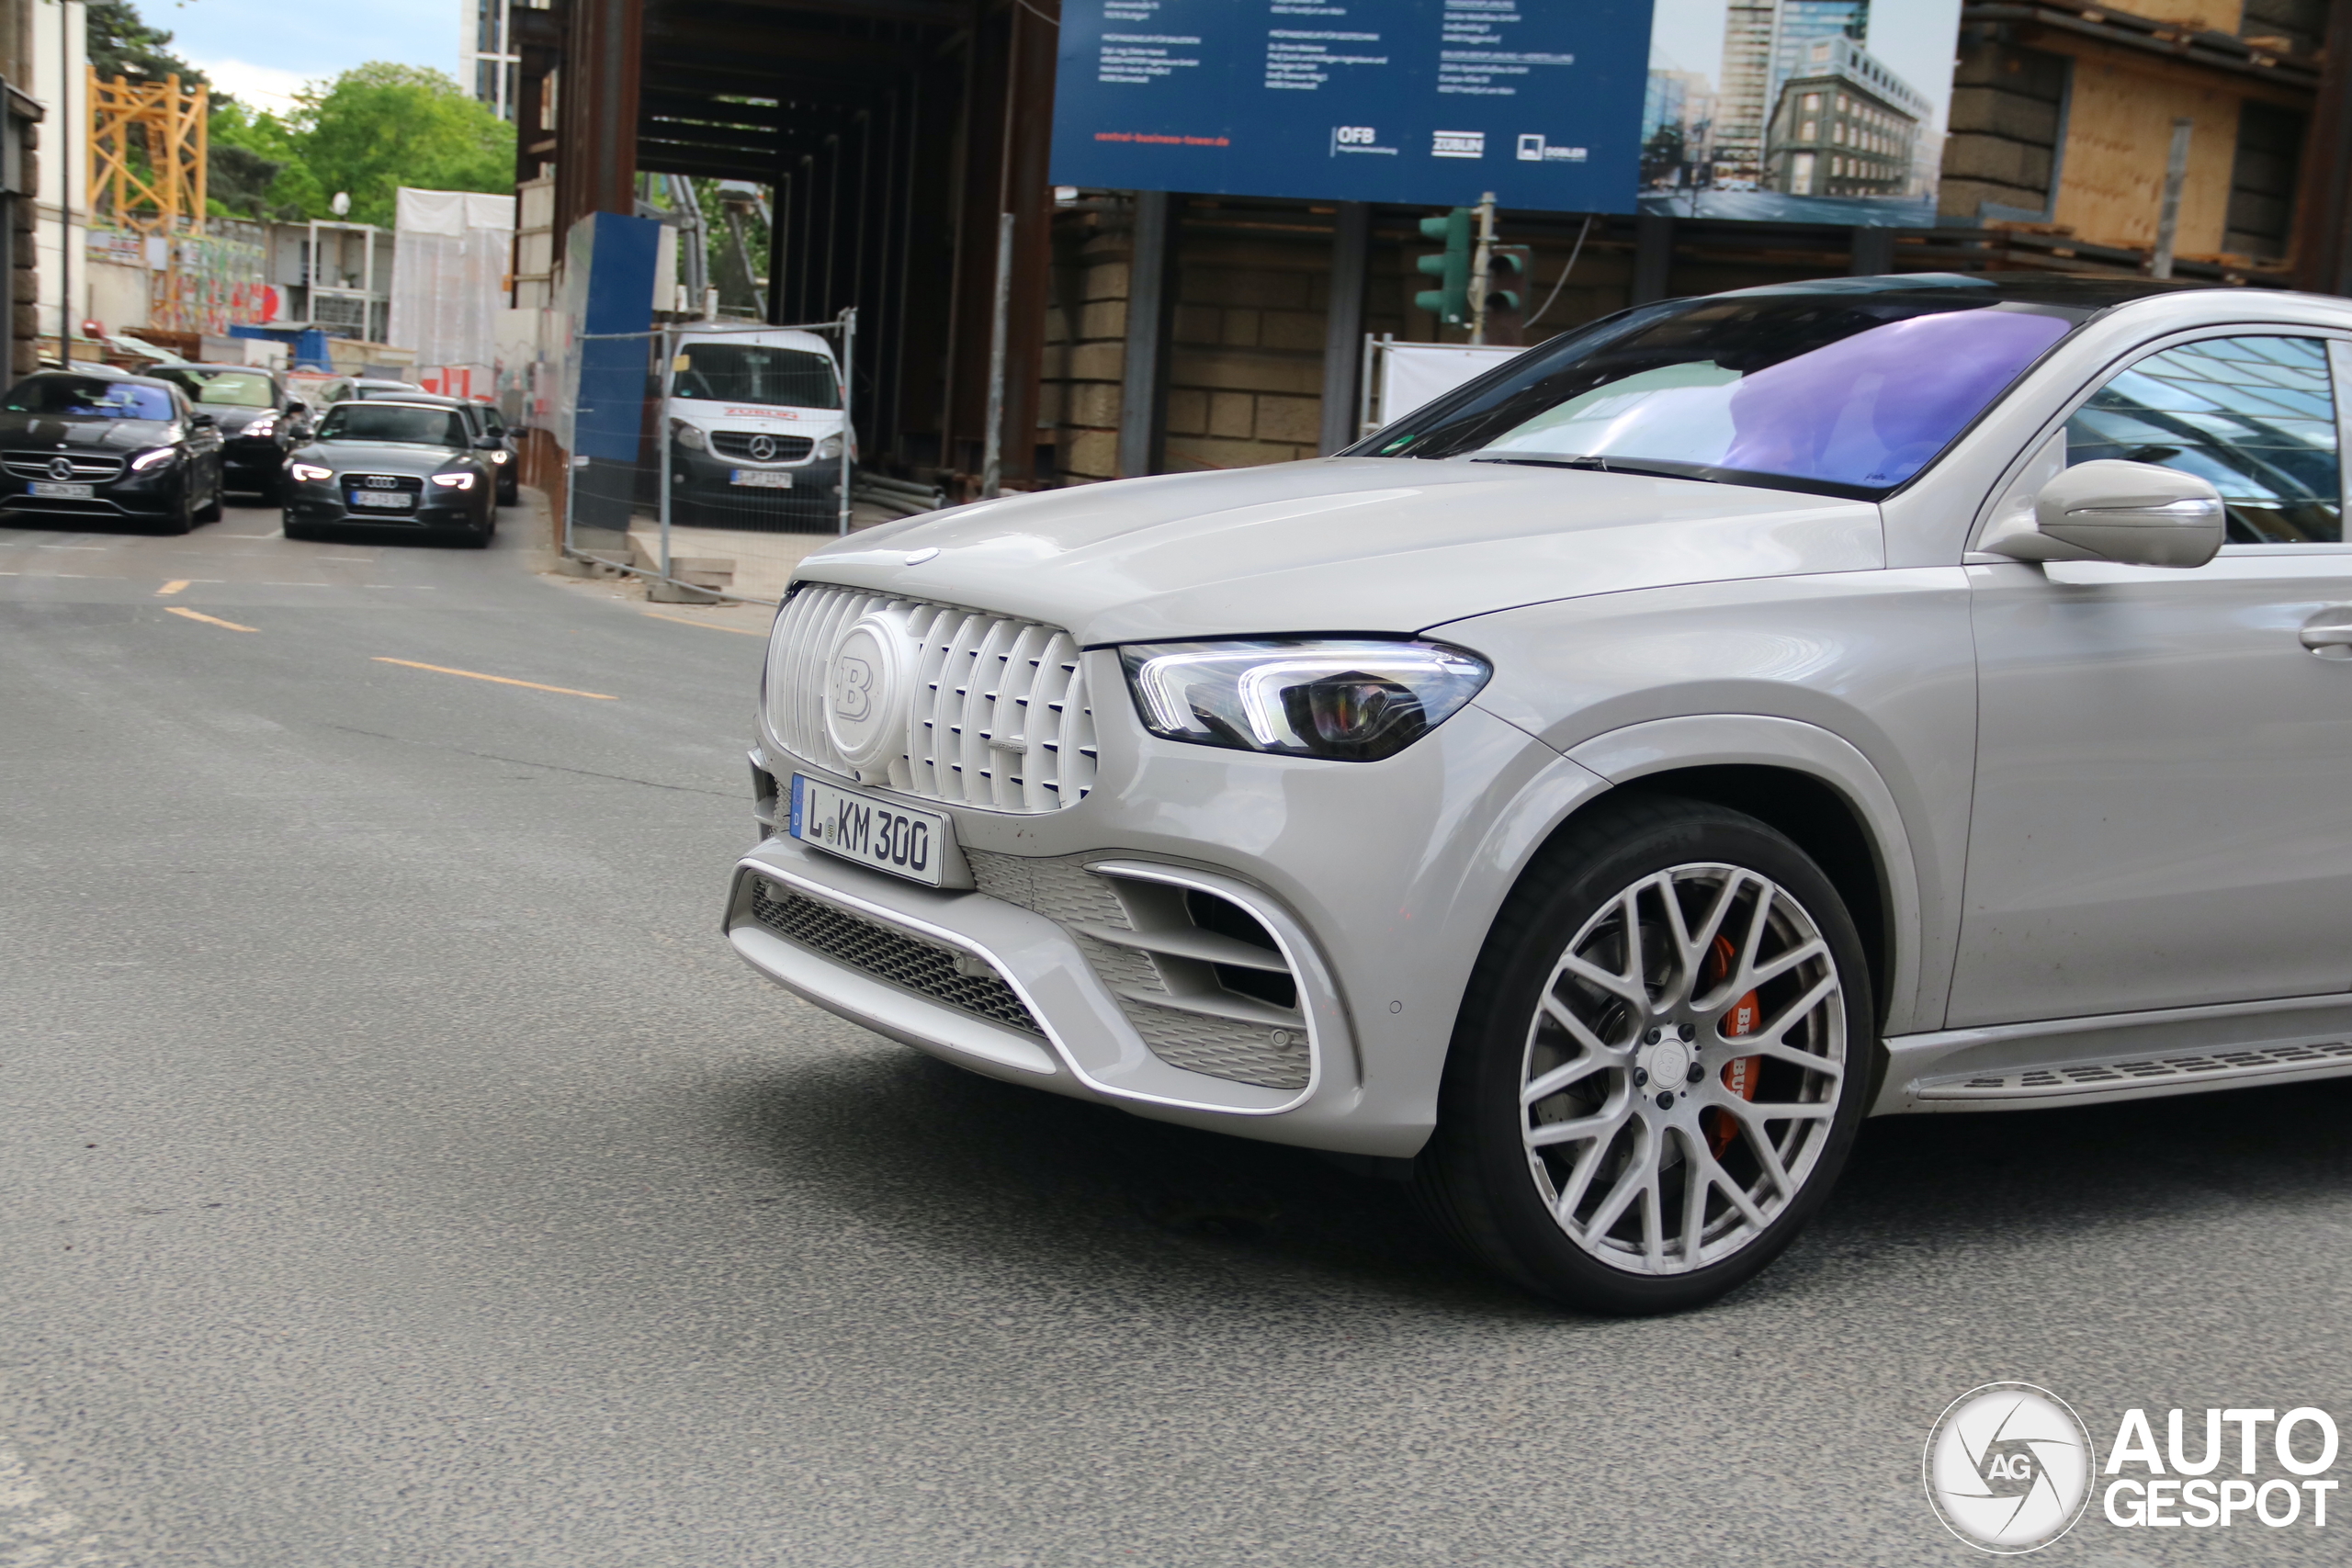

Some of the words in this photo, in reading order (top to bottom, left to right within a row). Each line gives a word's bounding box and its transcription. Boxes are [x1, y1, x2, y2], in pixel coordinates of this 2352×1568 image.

[1338, 126, 1375, 144] OFB
[836, 656, 874, 722] B
[794, 813, 799, 826] D
[809, 788, 822, 838] L
[837, 798, 871, 854] KM
[875, 810, 929, 871] 300
[1731, 1007, 1751, 1100] BRBU
